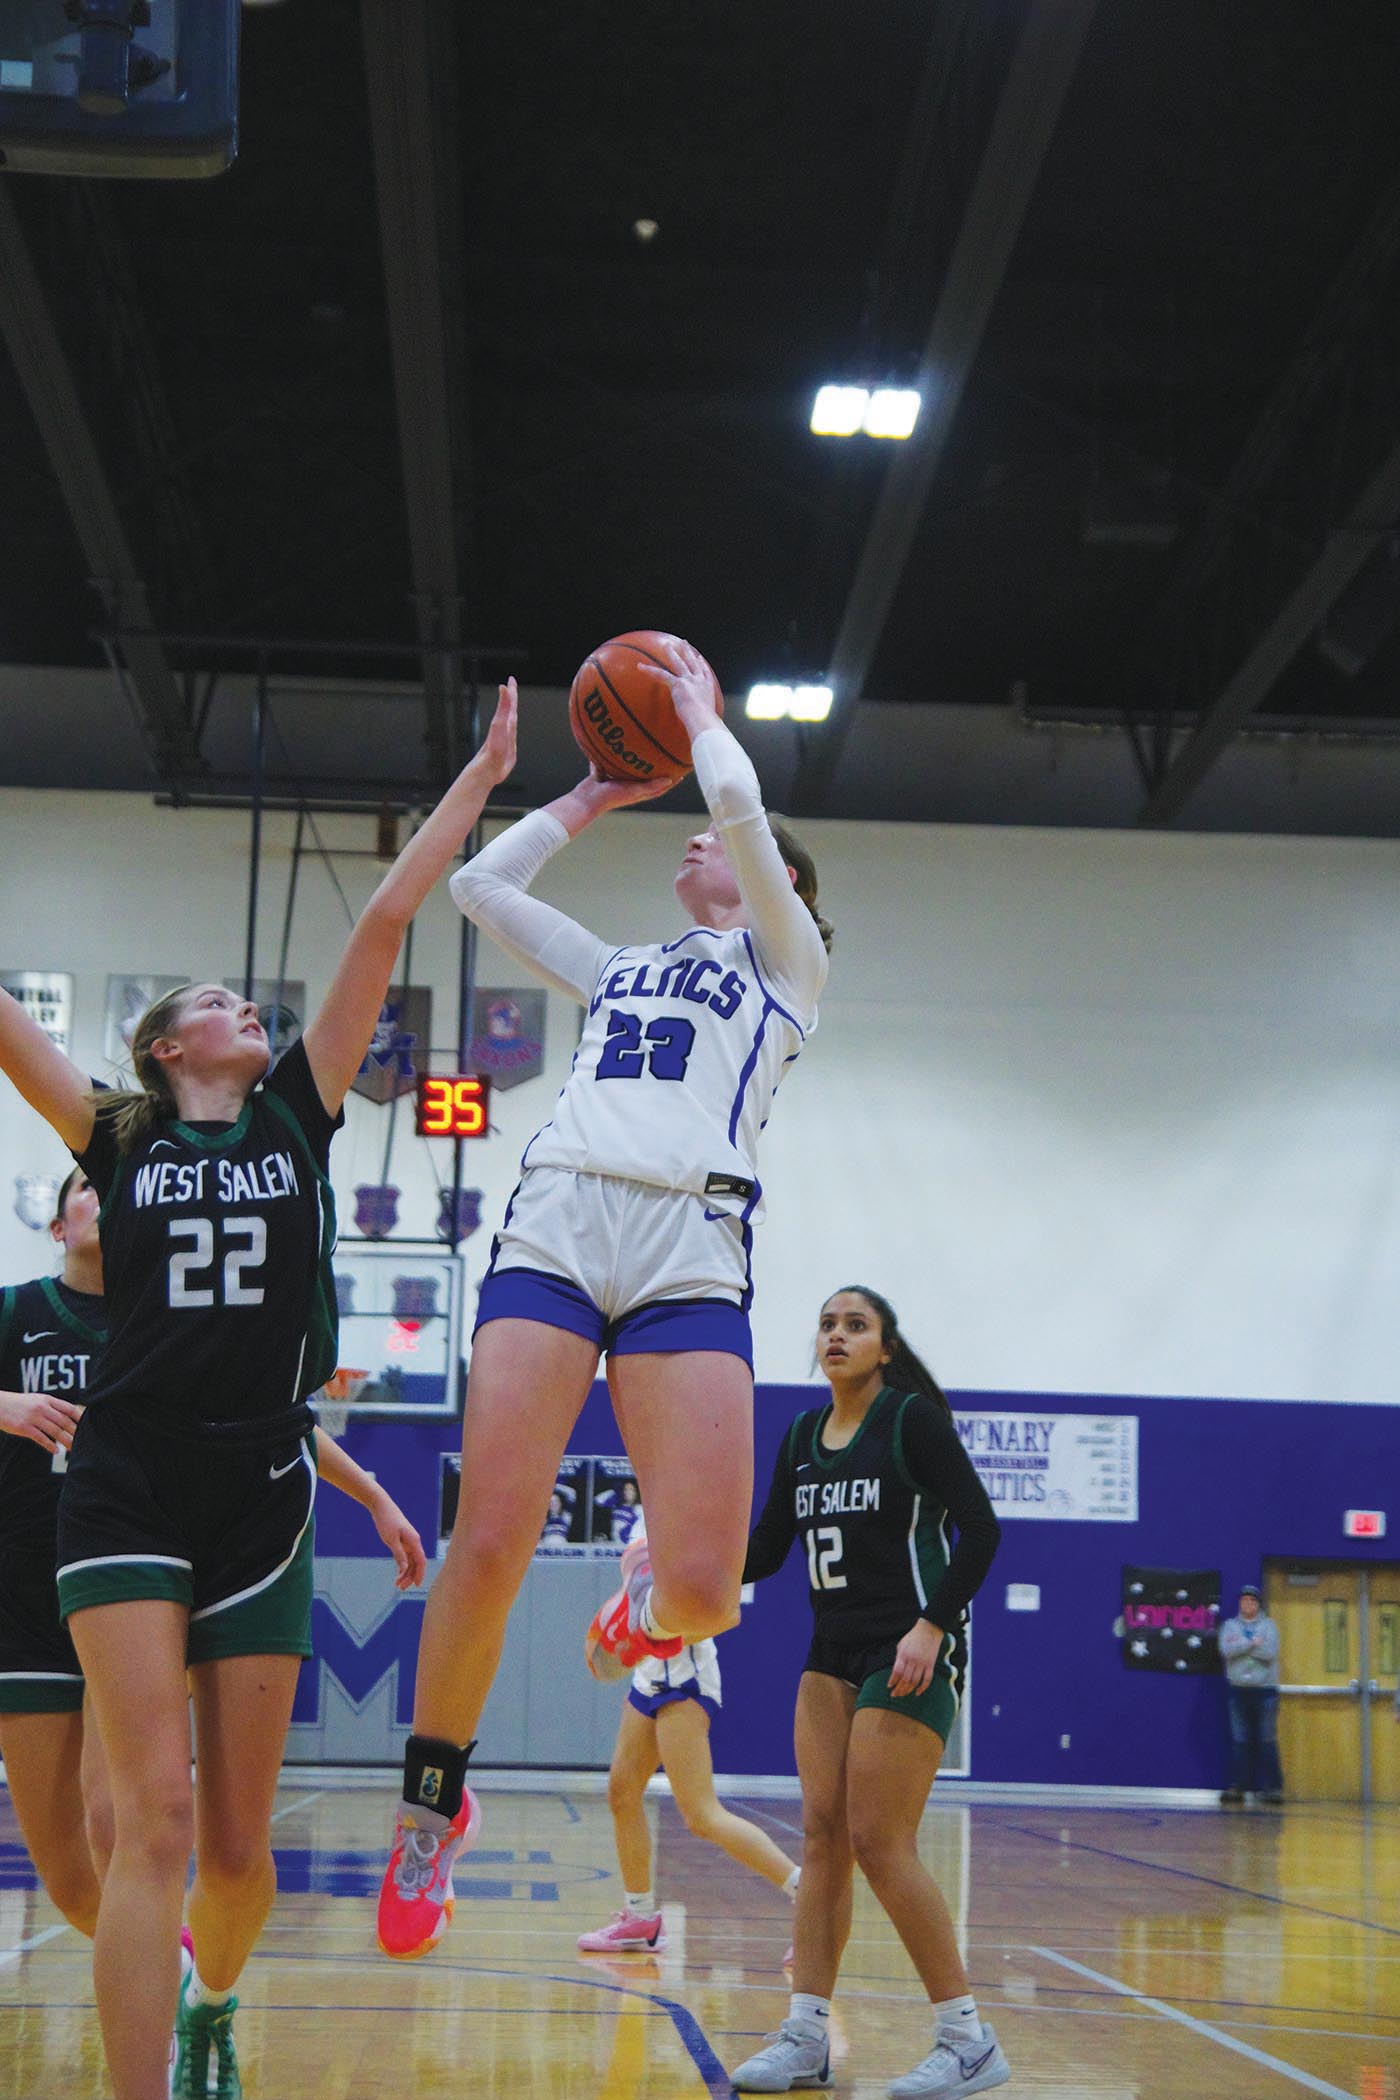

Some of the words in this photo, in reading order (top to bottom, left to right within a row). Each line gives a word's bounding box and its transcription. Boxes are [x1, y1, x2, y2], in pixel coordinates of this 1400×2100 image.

[584, 687, 655, 775] Wilson
[595, 1009, 696, 1082] 23
[424, 1078, 484, 1133] 35
[135, 1159, 209, 1209] WEST
[218, 1152, 299, 1203] SALEM
[169, 1216, 267, 1308] 22
[20, 1355, 90, 1394] WEST
[796, 1484, 819, 1519] EST
[820, 1479, 880, 1515] SALEM
[984, 1472, 1047, 1502] LTICS
[806, 1526, 848, 1591] 12
